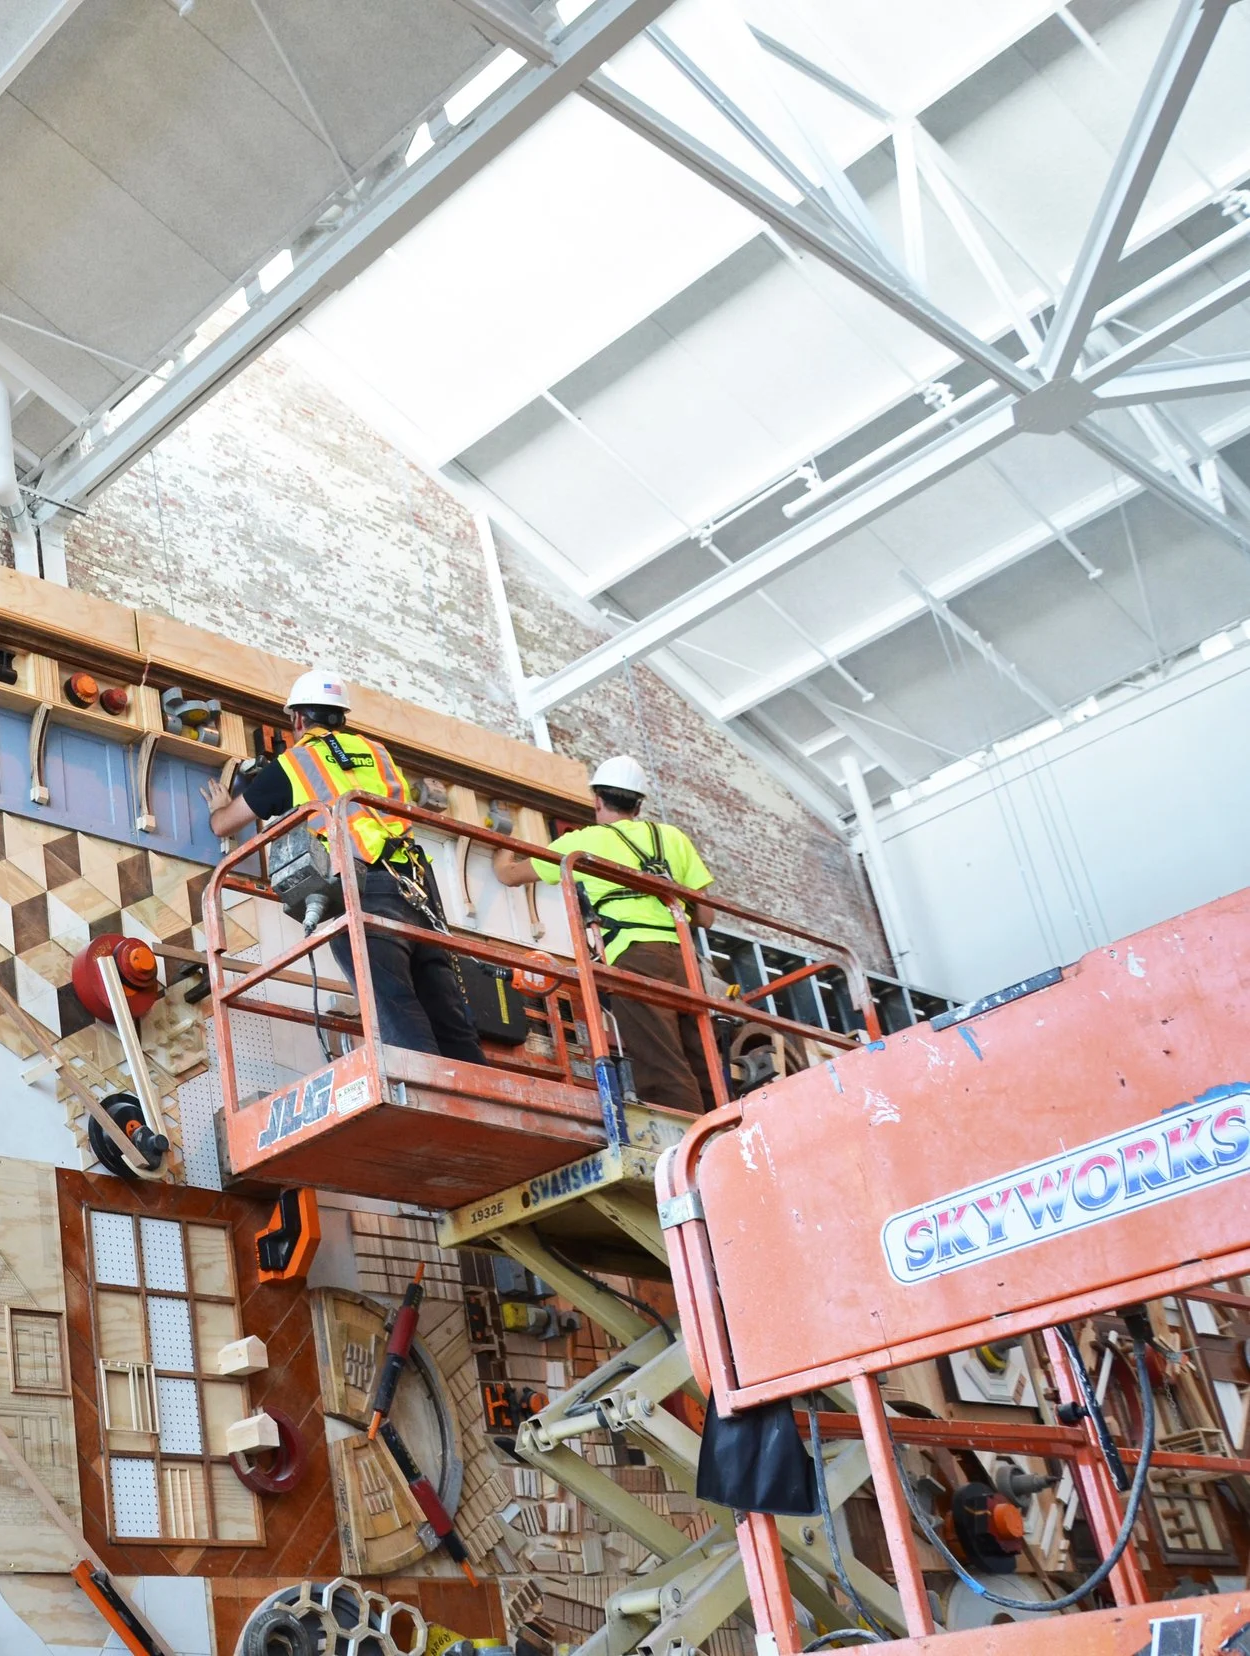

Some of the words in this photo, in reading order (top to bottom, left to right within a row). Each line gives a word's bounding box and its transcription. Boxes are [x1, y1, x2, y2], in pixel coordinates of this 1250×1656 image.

[257, 1068, 334, 1151] JLG
[471, 1202, 504, 1224] 1932E
[905, 1105, 1250, 1271] SKYWORKS
